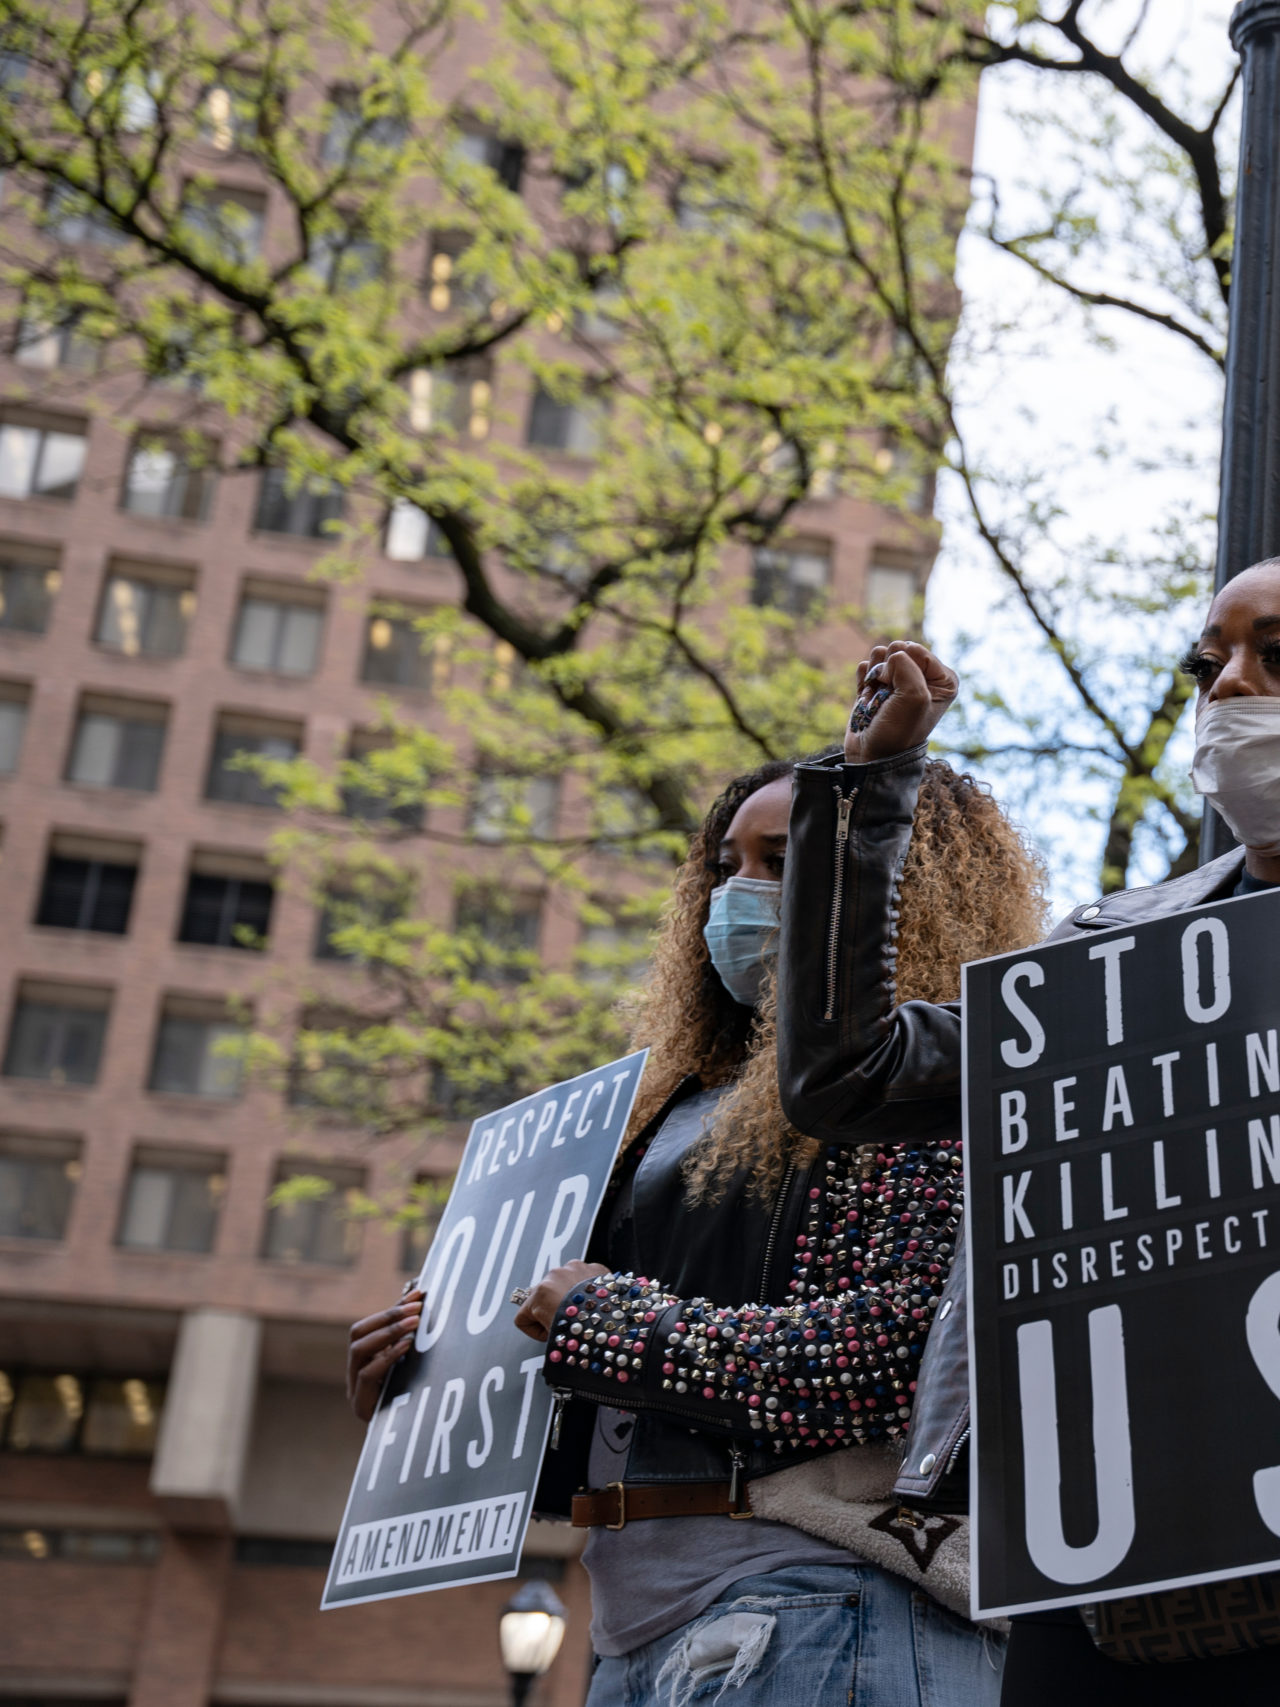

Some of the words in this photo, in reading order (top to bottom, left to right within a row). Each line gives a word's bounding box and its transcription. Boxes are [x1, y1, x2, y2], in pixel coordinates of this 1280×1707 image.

[467, 1070, 632, 1185] RESPECT
[415, 1174, 590, 1353] OUR
[366, 1354, 546, 1491] FIRST
[342, 1501, 518, 1577] AMENDMENT!
